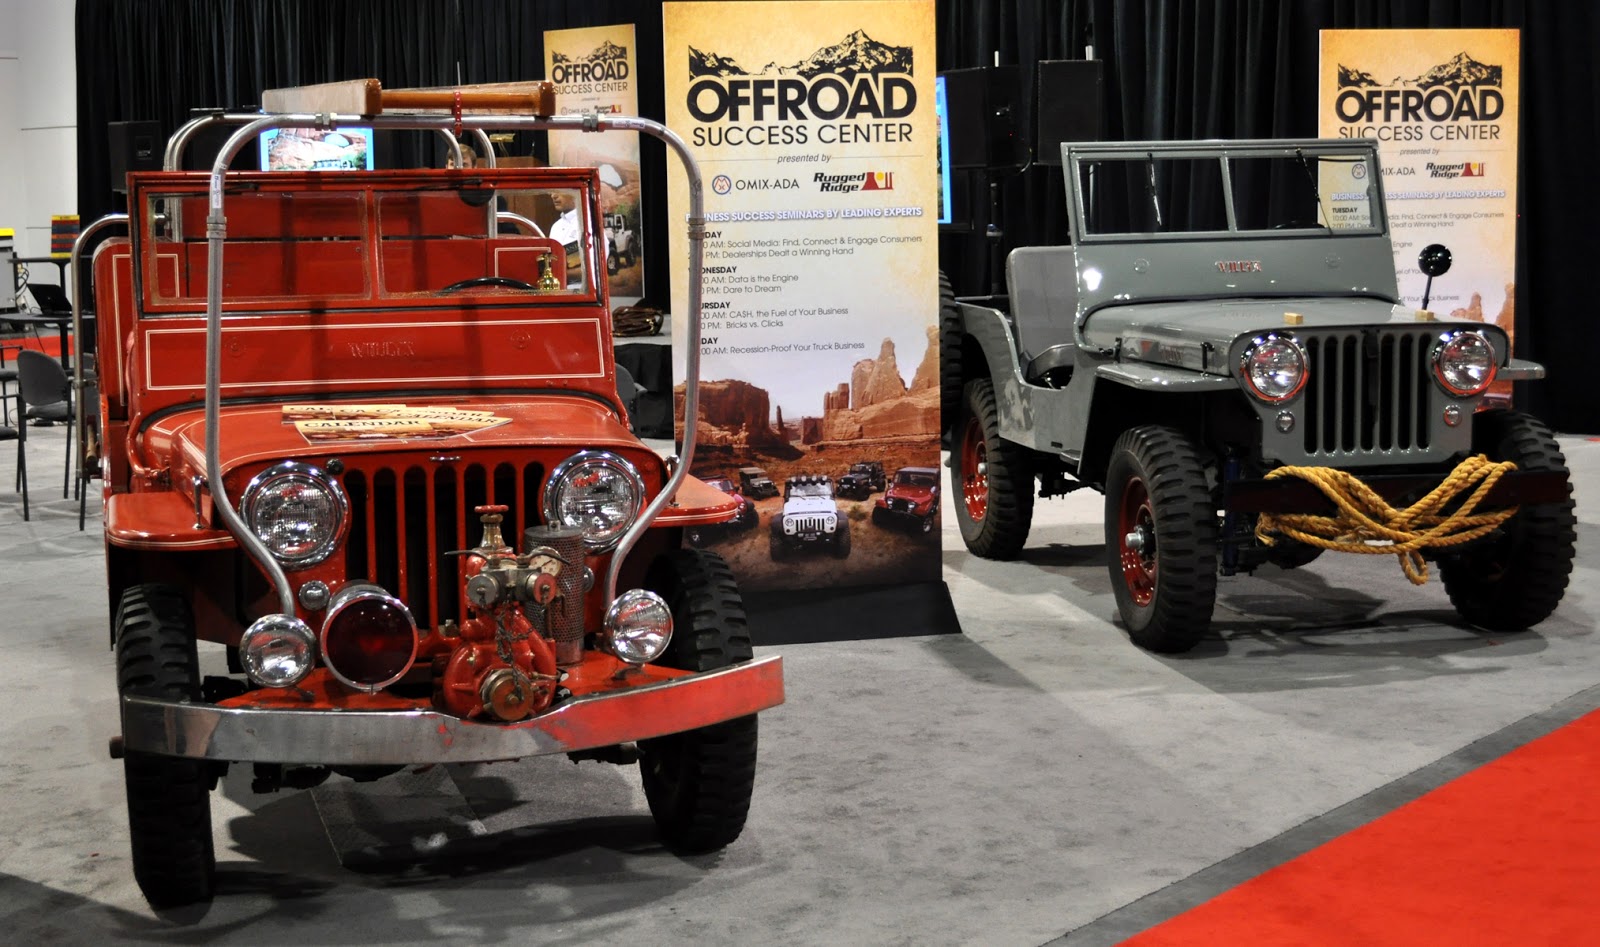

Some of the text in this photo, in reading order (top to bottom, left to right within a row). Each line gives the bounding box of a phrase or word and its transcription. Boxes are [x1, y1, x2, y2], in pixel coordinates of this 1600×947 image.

[552, 61, 629, 84] OFFROAD
[554, 82, 628, 95] SUCCESS CENTER
[686, 77, 917, 123] OFFROAD
[1335, 88, 1504, 123] OFFROAD
[692, 123, 913, 147] SUCCESS CENTER
[1338, 124, 1500, 141] SUCCESS CENTER
[777, 153, 832, 165] presented by
[1426, 162, 1464, 172] Rugged
[813, 172, 866, 185] Rugged
[1430, 171, 1459, 179] Ridge
[735, 178, 800, 191] OMIX-ADA
[820, 182, 859, 194] Ridge
[1331, 193, 1364, 201] BUSINESS
[1399, 191, 1434, 199] SEMINARS
[1476, 190, 1505, 198] EXPERTS
[731, 211, 775, 222] SUCCESS
[777, 209, 825, 220] SEMINARS
[826, 209, 839, 218] BY
[841, 208, 882, 218] LEADING
[883, 207, 922, 217] EXPERTS
[1449, 212, 1472, 220] Engage
[727, 240, 752, 248] Social
[753, 239, 780, 247] Media:
[803, 237, 838, 246] Connect
[840, 237, 846, 245] &
[847, 236, 878, 245] Engage
[880, 235, 923, 244] Consumers
[705, 251, 721, 259] PM:
[722, 250, 767, 259] Dealerships
[769, 249, 790, 257] Dealt
[799, 248, 830, 257] Winning
[832, 247, 854, 255] Hand
[728, 275, 749, 283] Data
[772, 274, 799, 283] Engine
[723, 286, 742, 294] Dare
[744, 285, 753, 293] to
[754, 285, 782, 293] Dream
[771, 309, 787, 317] Fuel
[789, 308, 797, 316] of
[798, 308, 816, 316] Your
[818, 307, 849, 315] Business
[726, 321, 748, 329] Bricks
[761, 320, 784, 328] Clicks
[701, 337, 719, 345] DAY
[712, 347, 728, 355] AM:
[730, 344, 792, 354] Recession-Proof
[793, 344, 811, 352] Your
[812, 343, 832, 351] Truck
[834, 342, 865, 350] Business
